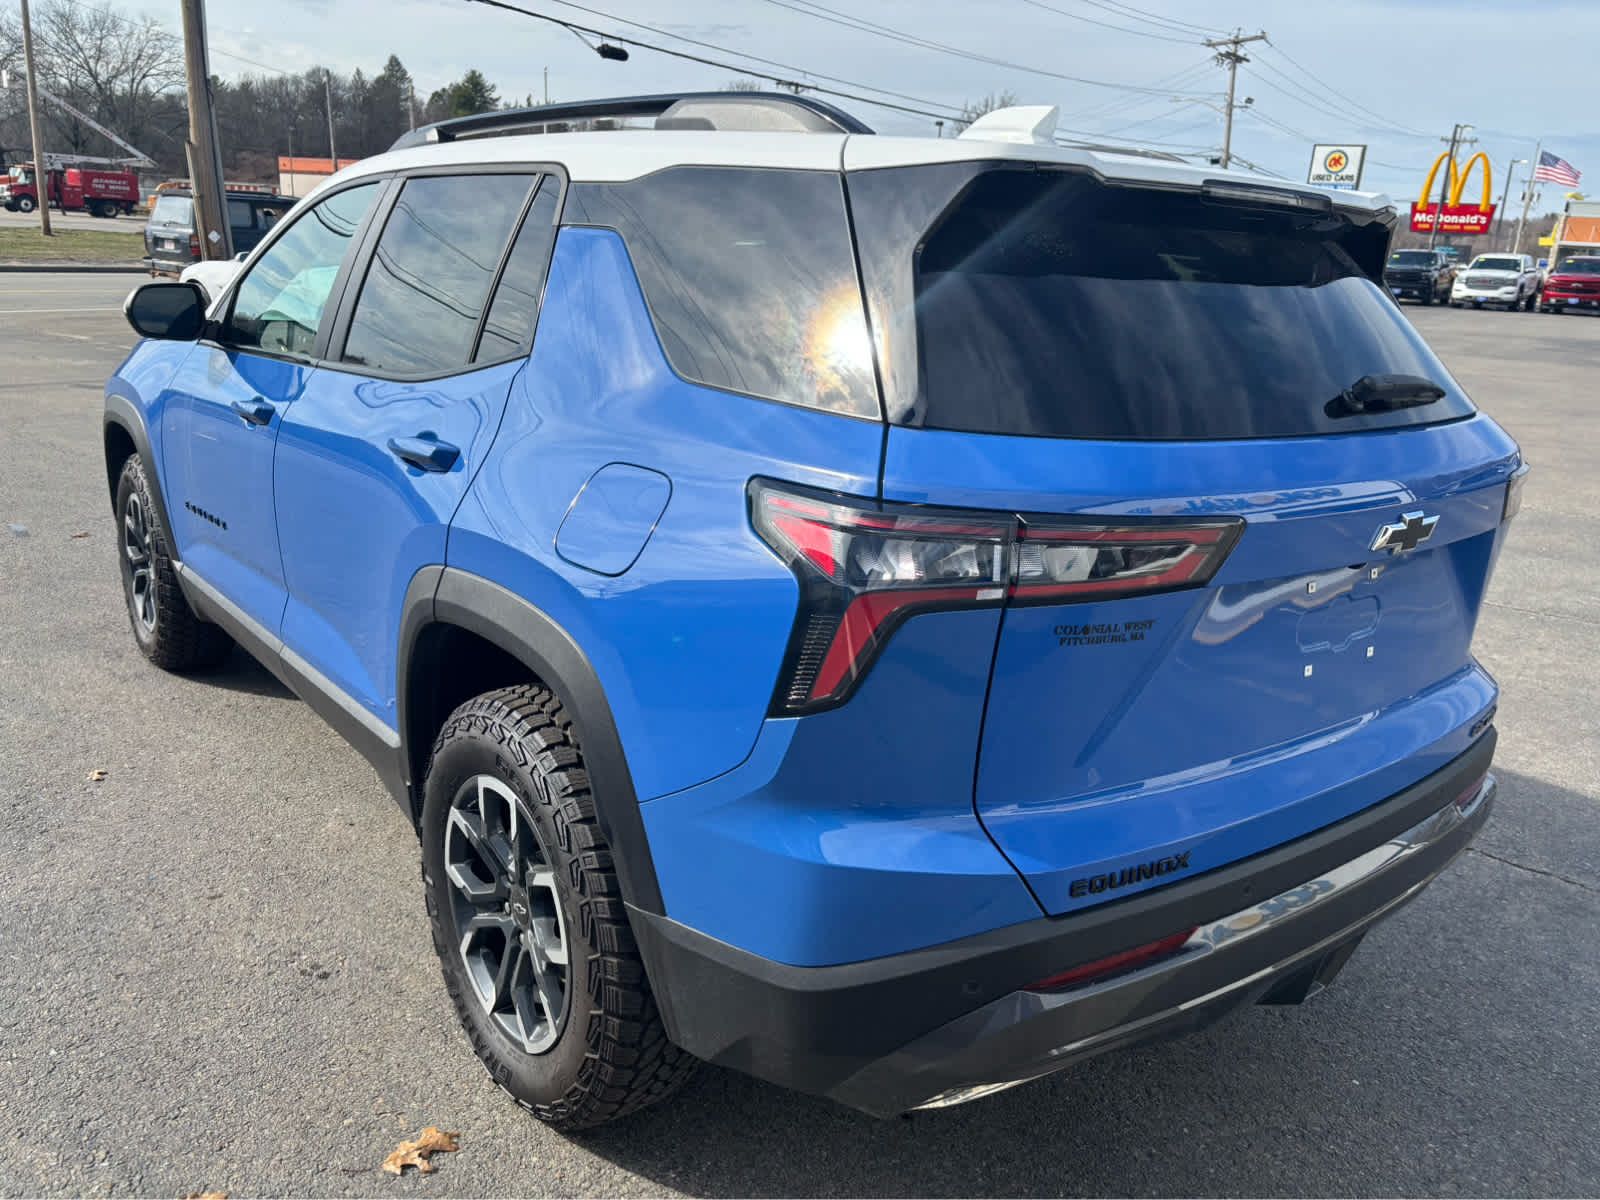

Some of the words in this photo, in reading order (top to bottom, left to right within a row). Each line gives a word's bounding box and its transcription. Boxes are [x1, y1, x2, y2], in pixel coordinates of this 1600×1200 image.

[1312, 174, 1332, 182] USED
[1334, 174, 1355, 182] CARS
[1069, 851, 1192, 898] EQUINOX
